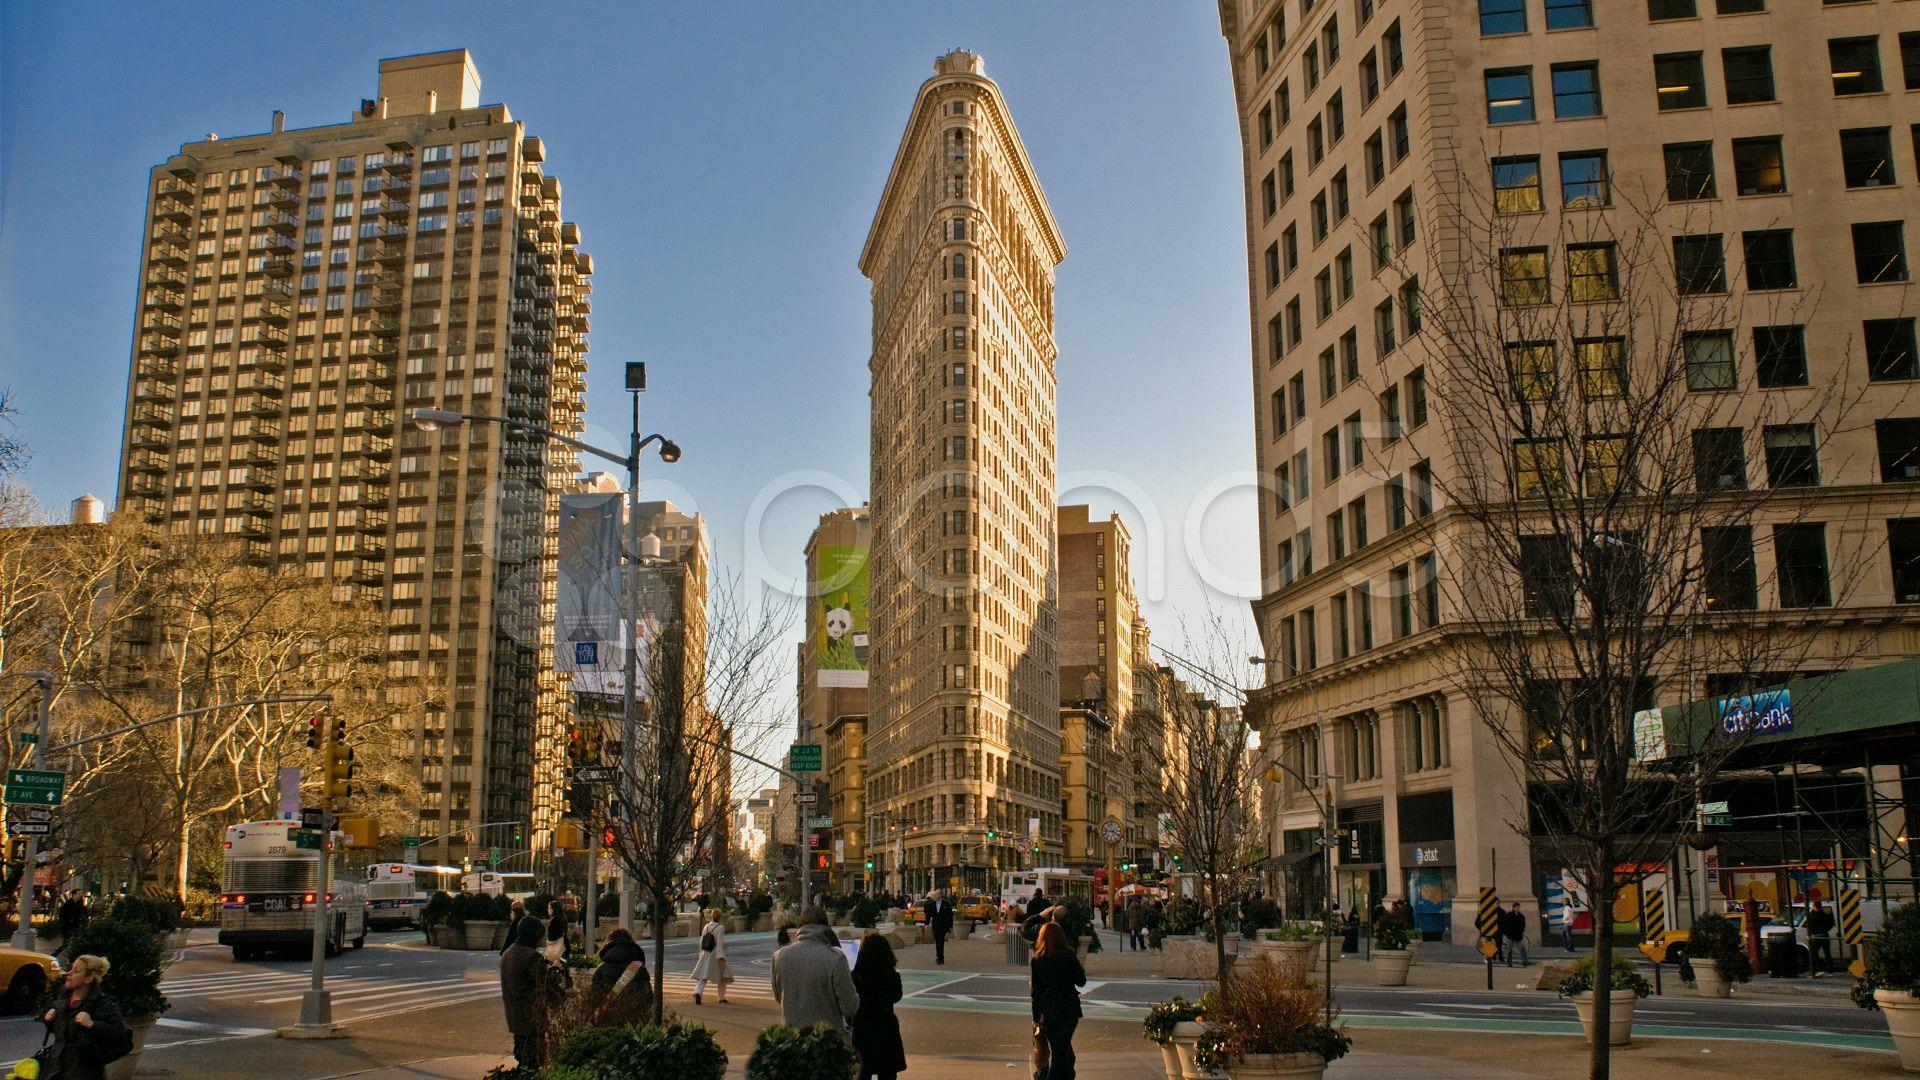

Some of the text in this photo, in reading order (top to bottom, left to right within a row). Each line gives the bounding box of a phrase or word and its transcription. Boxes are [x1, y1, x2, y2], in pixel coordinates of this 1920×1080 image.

[26, 775, 63, 784] BROADWAY
[12, 790, 34, 799] 5 AVE
[1423, 848, 1439, 862] at&t
